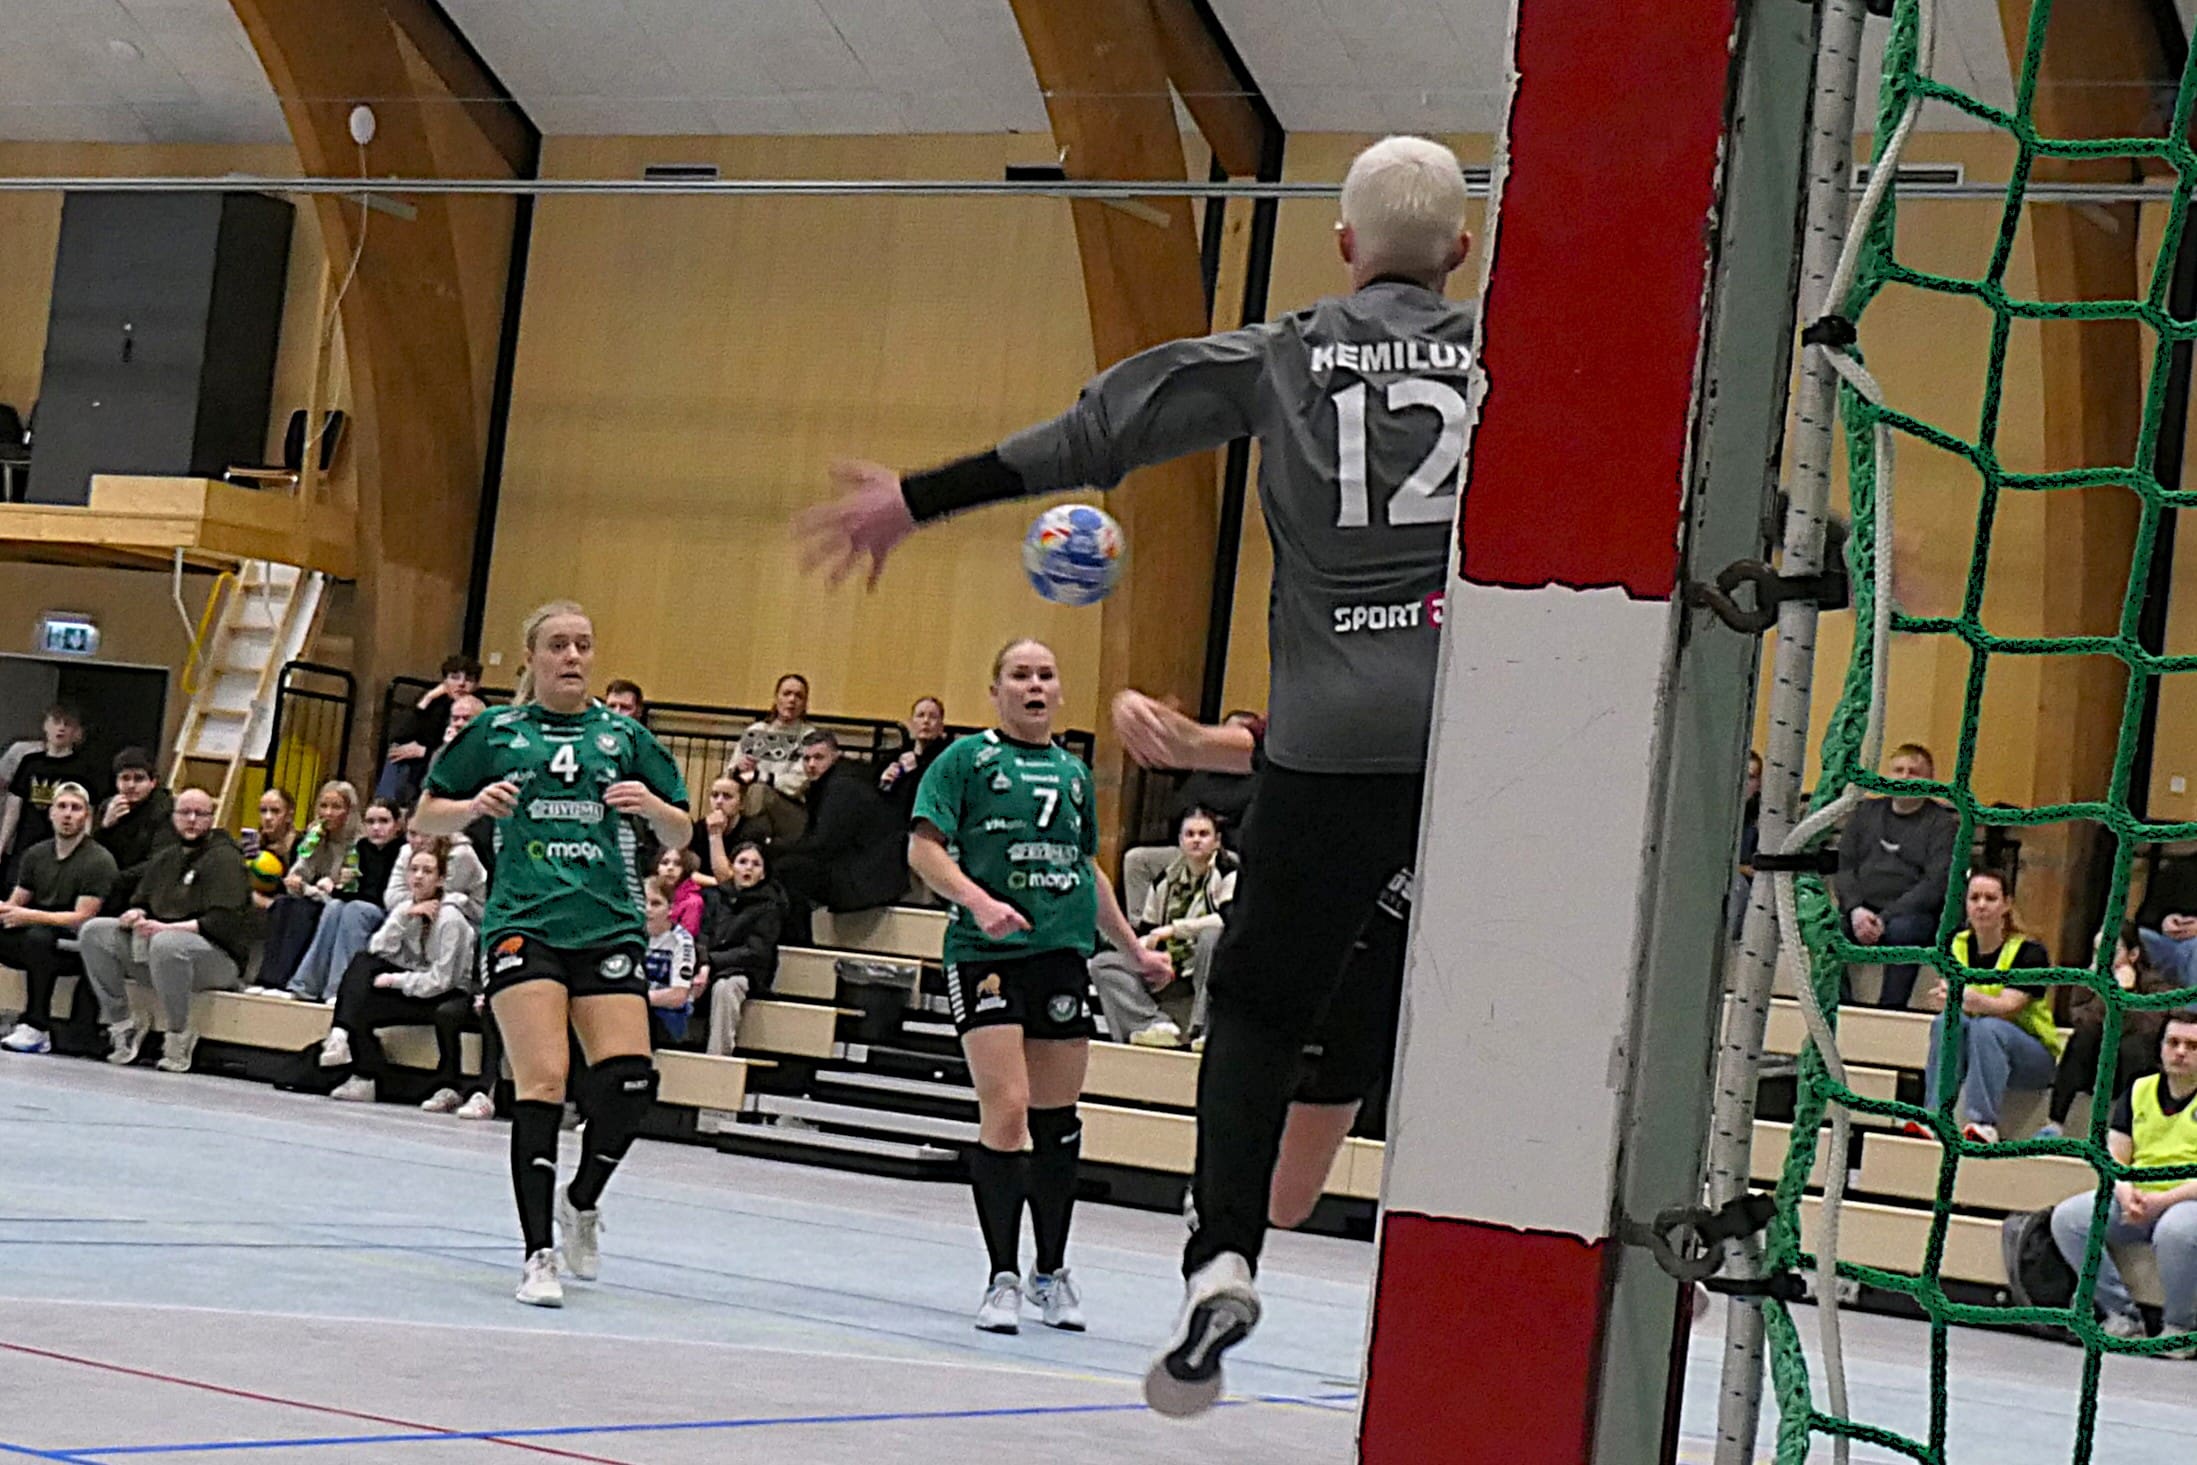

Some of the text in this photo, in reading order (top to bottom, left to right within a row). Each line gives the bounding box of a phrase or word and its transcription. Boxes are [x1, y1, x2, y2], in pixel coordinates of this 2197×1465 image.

[1331, 378, 1467, 527] 12
[1334, 601, 1422, 632] SPORT
[550, 743, 580, 783] 4
[1033, 786, 1059, 828] 7
